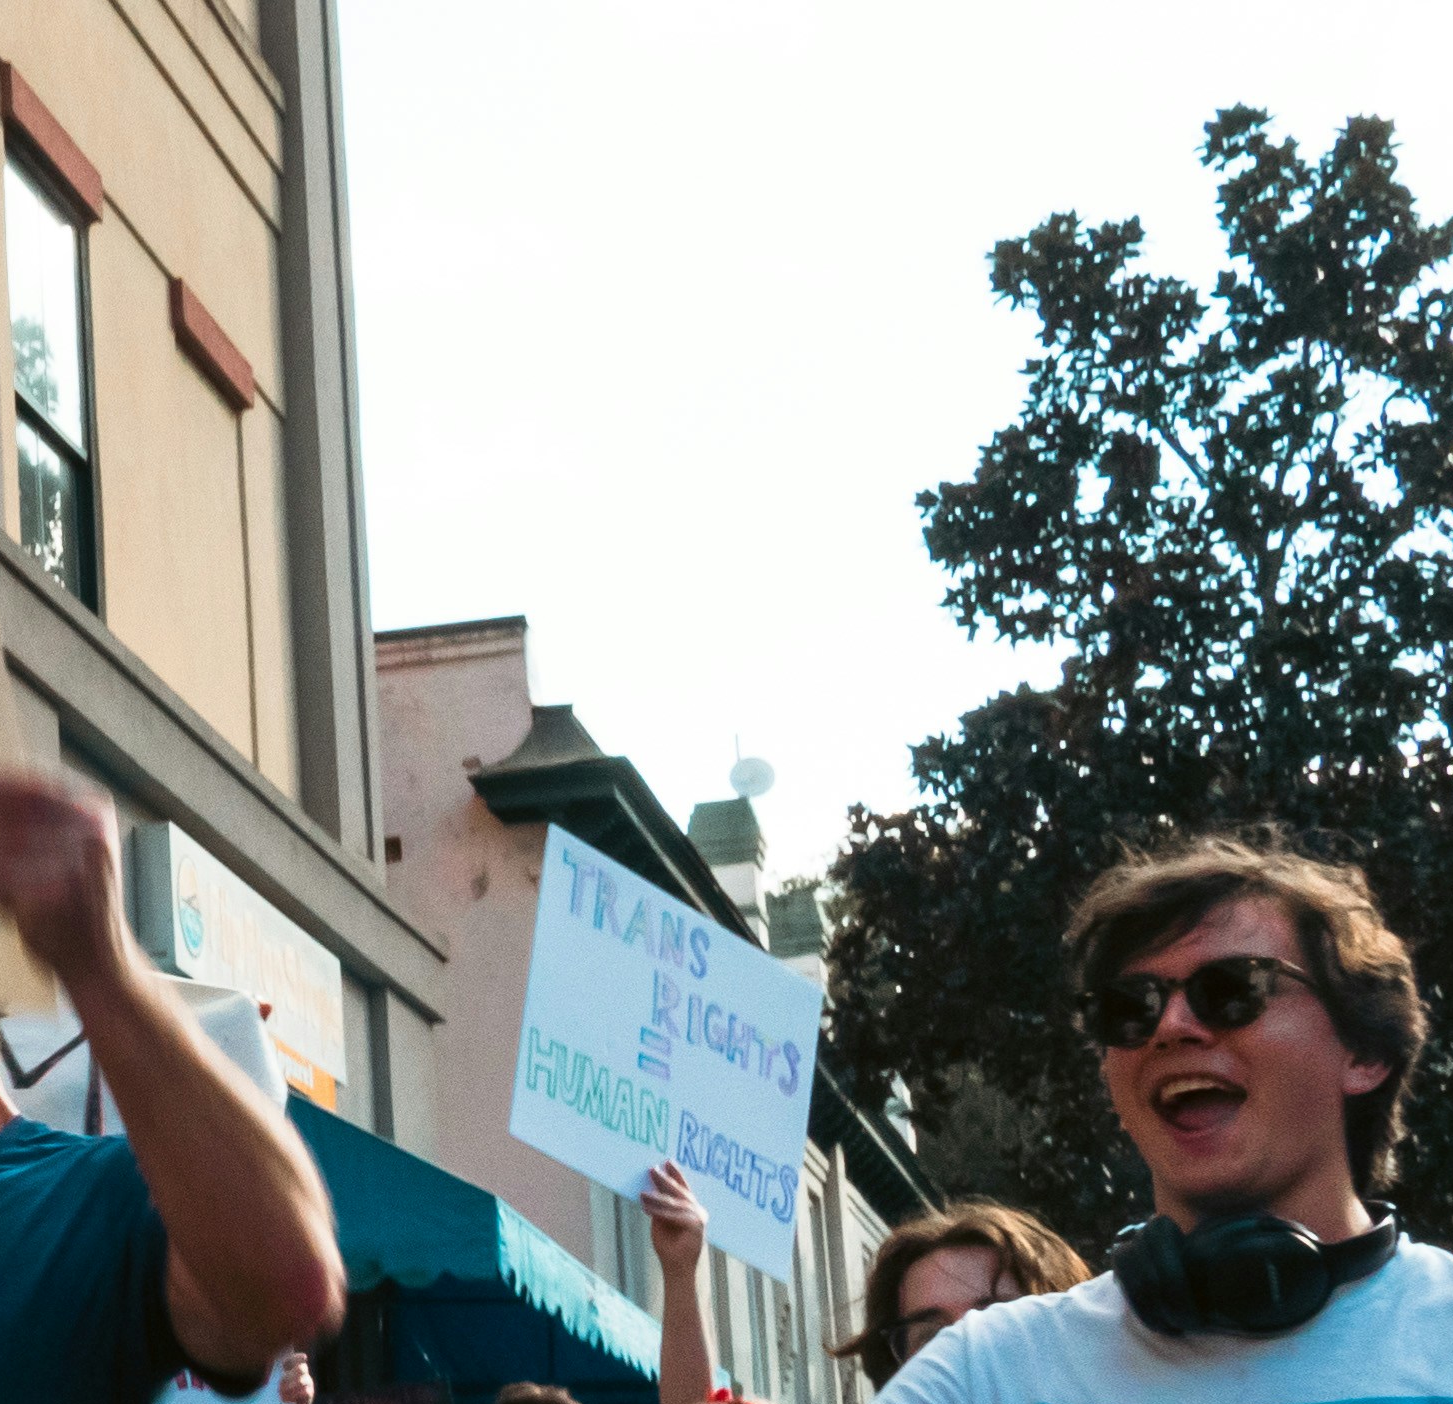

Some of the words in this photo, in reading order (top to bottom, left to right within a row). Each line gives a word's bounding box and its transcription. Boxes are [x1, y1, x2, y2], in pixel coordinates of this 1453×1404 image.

[563, 847, 711, 980] TRANS
[651, 969, 801, 1097] RIGHTS
[525, 1027, 671, 1154] HUMAN
[675, 1109, 800, 1224] RIGHTS
